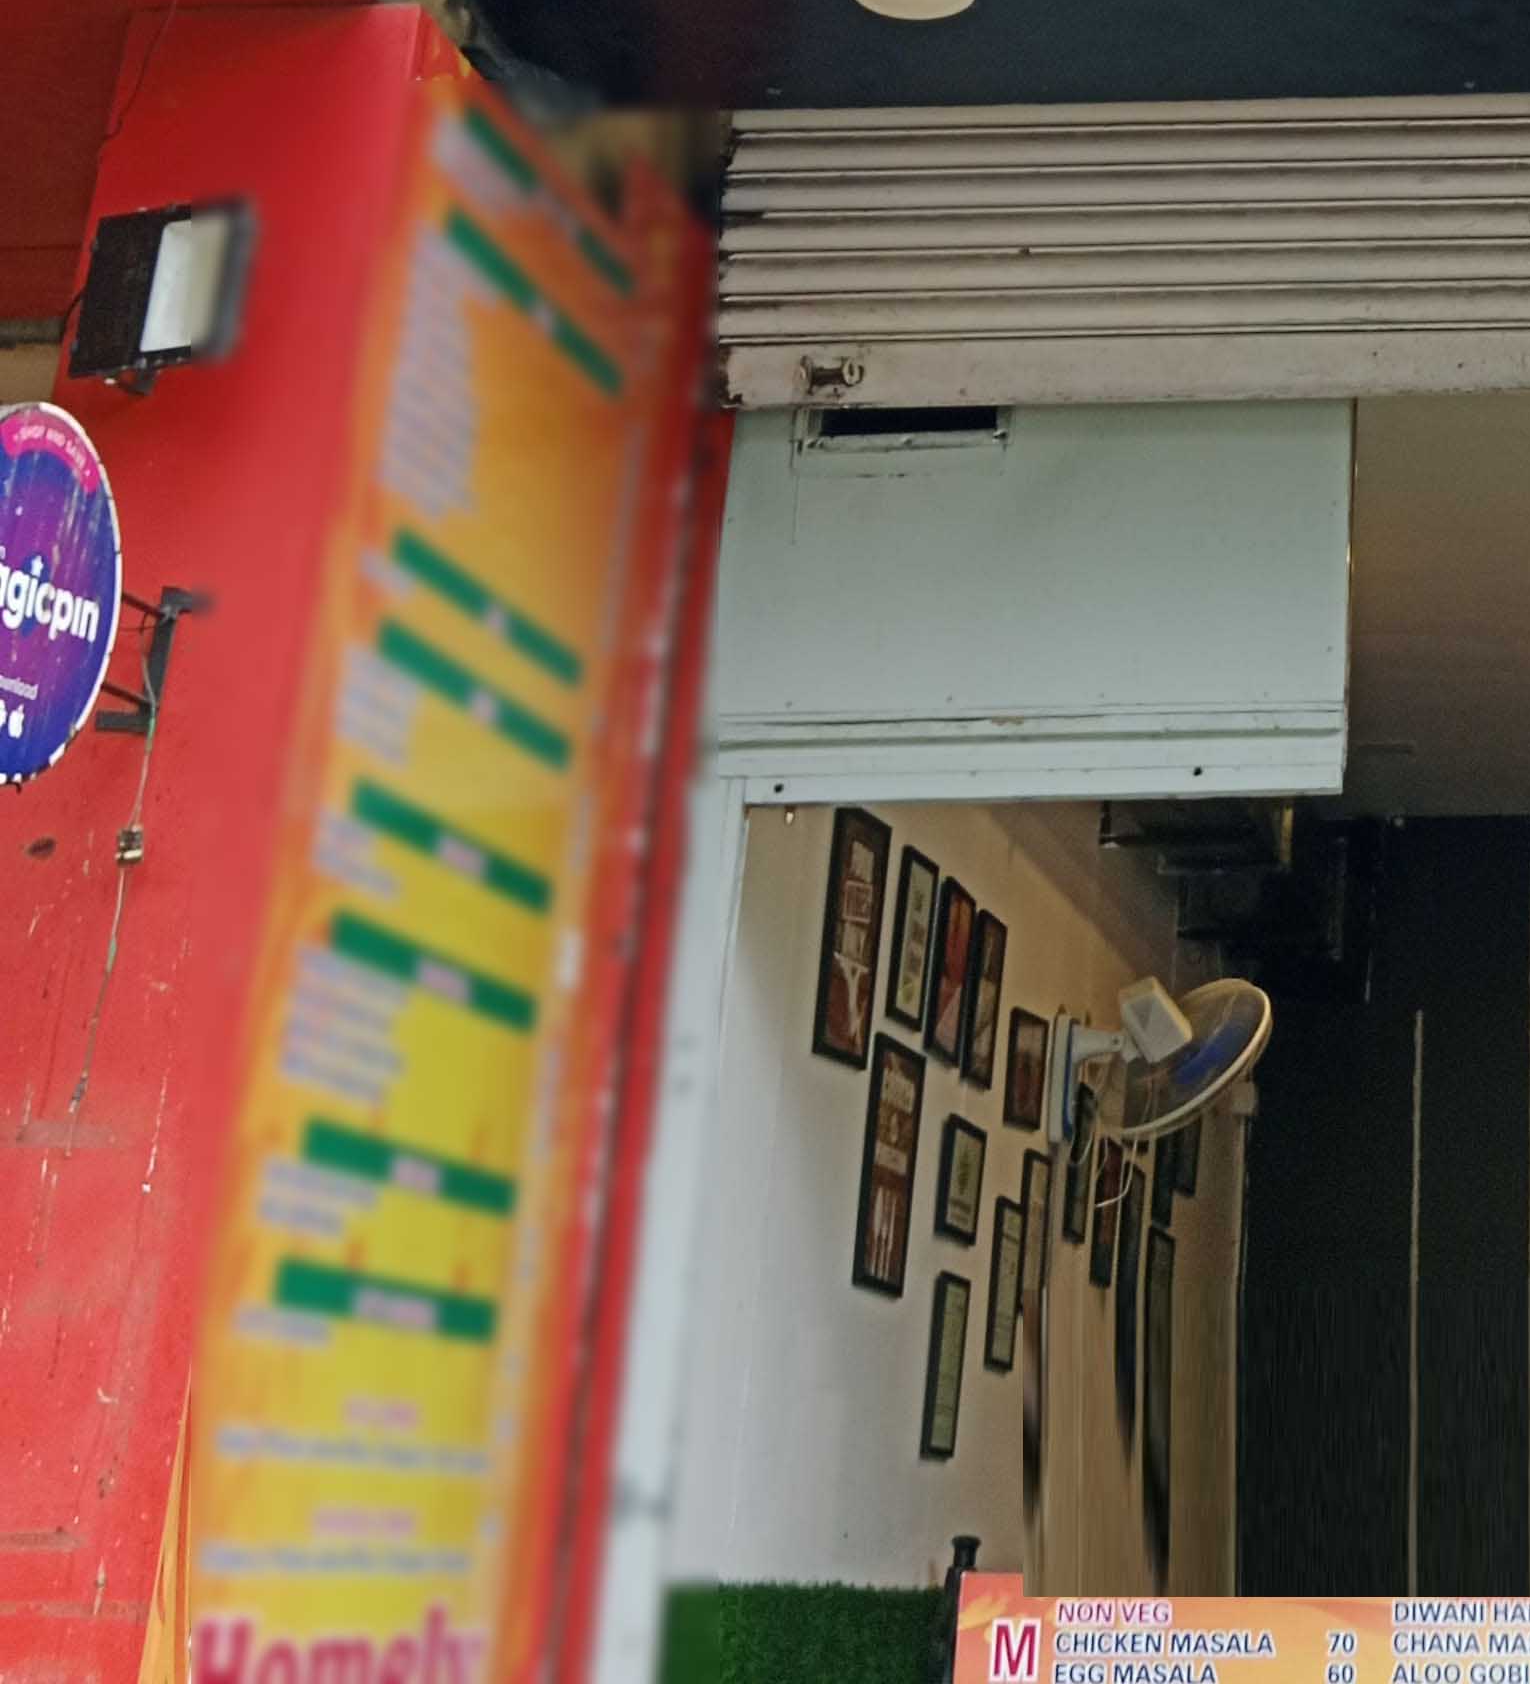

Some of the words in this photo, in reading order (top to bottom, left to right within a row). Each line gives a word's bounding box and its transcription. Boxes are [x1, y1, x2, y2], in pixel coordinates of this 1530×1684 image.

[1058, 1602, 1112, 1623] NON
[1121, 1602, 1170, 1623] VEG
[1394, 1602, 1485, 1623] DIWANI
[1055, 1633, 1163, 1654] CHICKEN
[1169, 1633, 1273, 1654] MASALA
[1328, 1633, 1355, 1654] 70
[1392, 1632, 1481, 1654] CHANA
[1054, 1664, 1105, 1684] EGG
[1113, 1664, 1216, 1684] MASALA
[1328, 1664, 1354, 1684] 60
[1392, 1663, 1461, 1684] ALOO
[1469, 1663, 1530, 1684] GOBI
